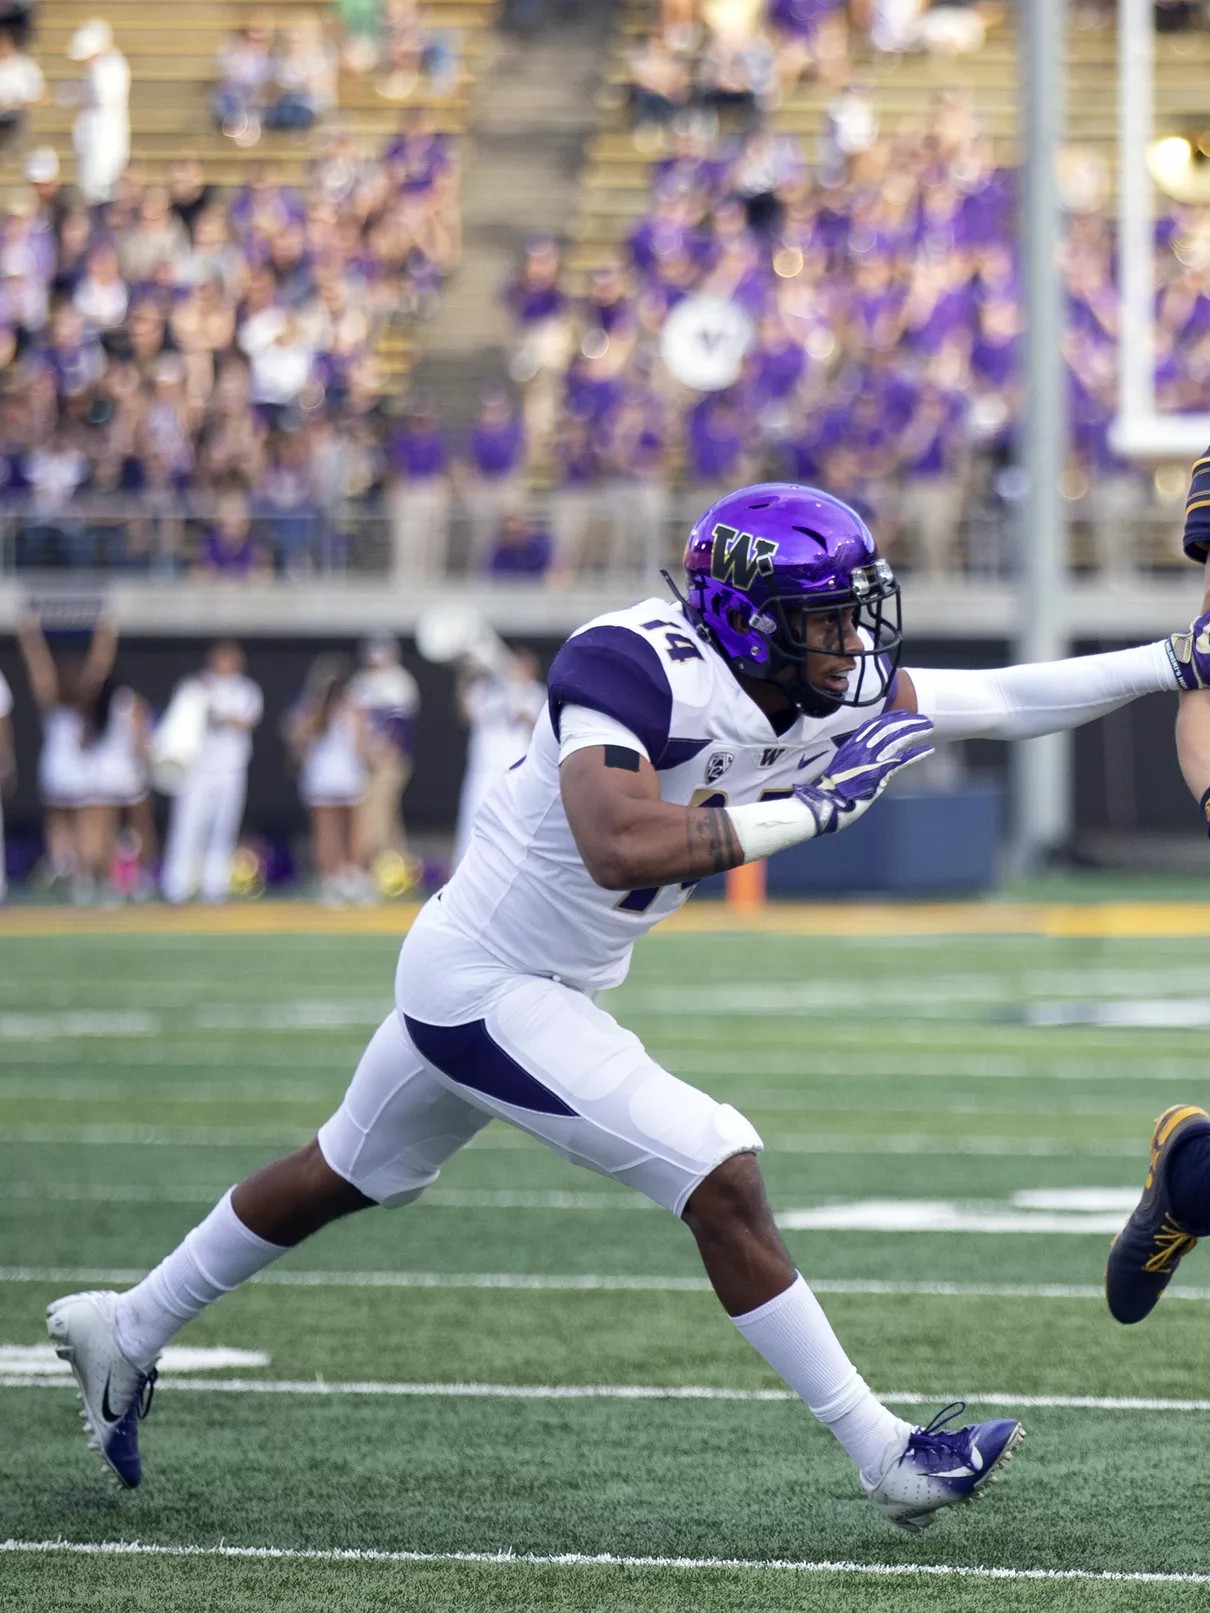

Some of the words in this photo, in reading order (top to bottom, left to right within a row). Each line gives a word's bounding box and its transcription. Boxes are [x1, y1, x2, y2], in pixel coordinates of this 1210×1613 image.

[711, 523, 779, 592] W
[638, 619, 706, 662] 14
[709, 752, 734, 772] PAC
[760, 749, 786, 767] W
[708, 766, 723, 778] 12
